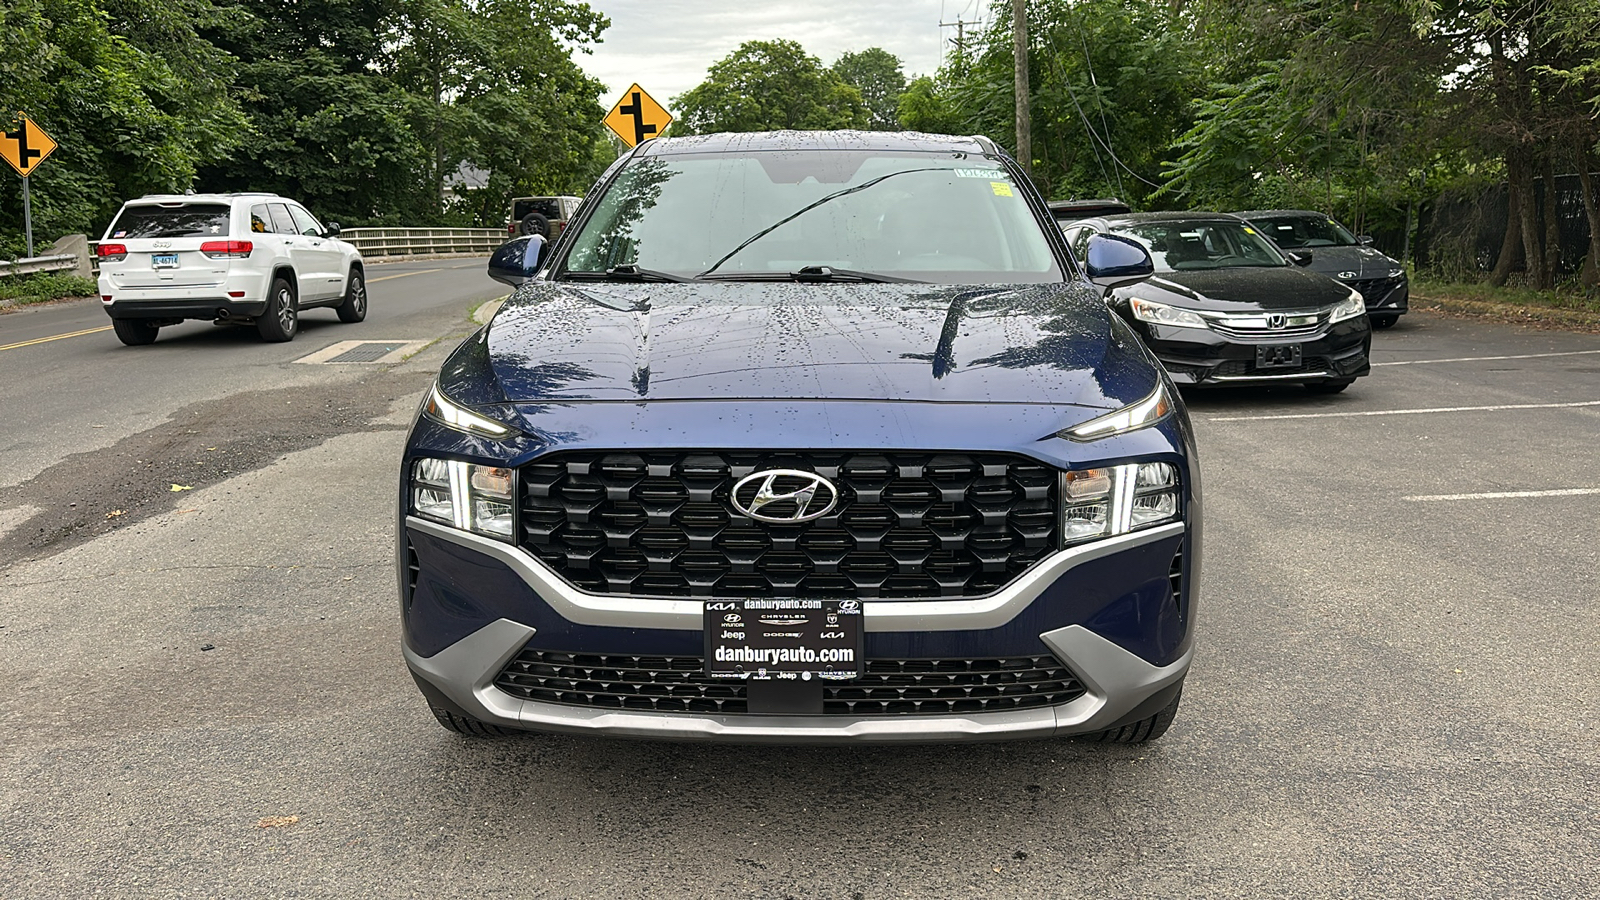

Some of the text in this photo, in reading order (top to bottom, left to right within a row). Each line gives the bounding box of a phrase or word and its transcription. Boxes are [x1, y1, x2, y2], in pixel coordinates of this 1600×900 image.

[706, 602, 736, 611] KIA
[744, 599, 822, 611] danburyauto.com
[720, 630, 746, 640] Jeep
[715, 645, 854, 665] danburyauto.com
[777, 671, 798, 680] Jeep
